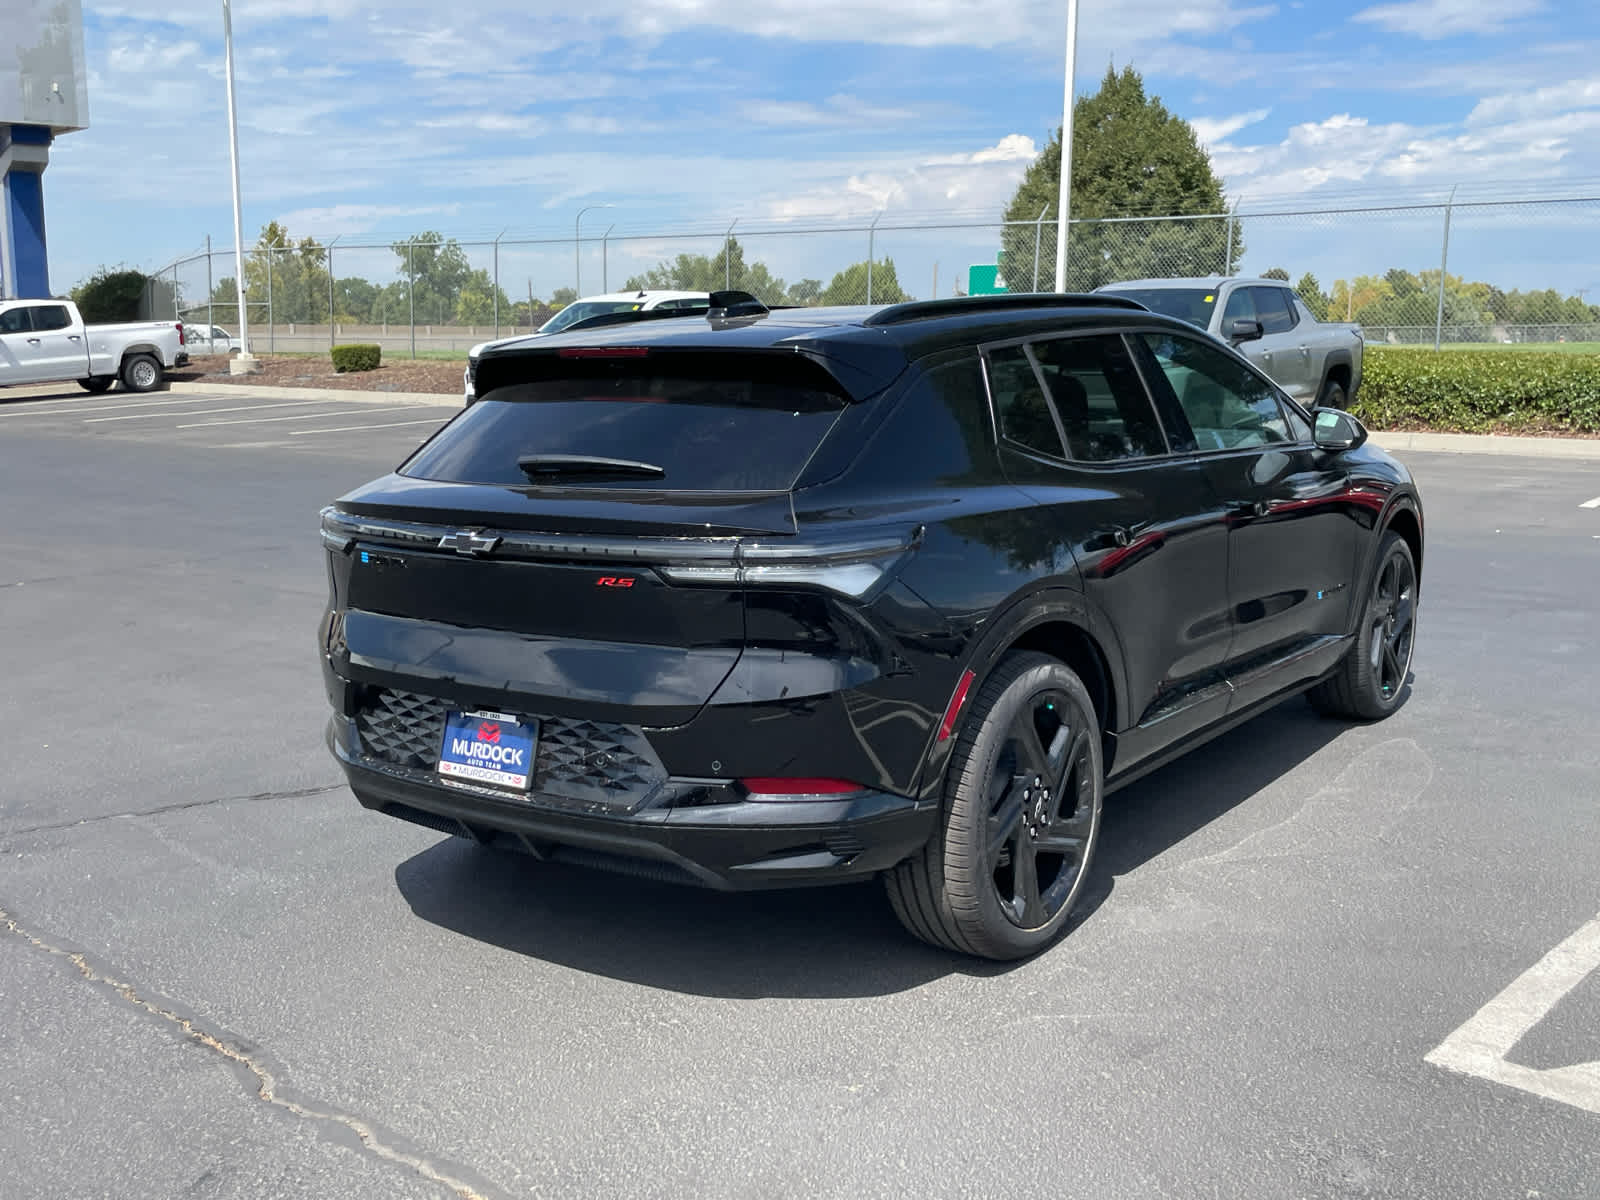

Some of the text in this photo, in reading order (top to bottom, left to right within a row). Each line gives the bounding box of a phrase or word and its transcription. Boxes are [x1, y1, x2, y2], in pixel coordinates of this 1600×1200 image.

[597, 577, 635, 588] RS
[452, 738, 523, 766] MURDOCK
[467, 758, 501, 770] AUTO TEAM
[458, 766, 507, 782] MURDOCK
